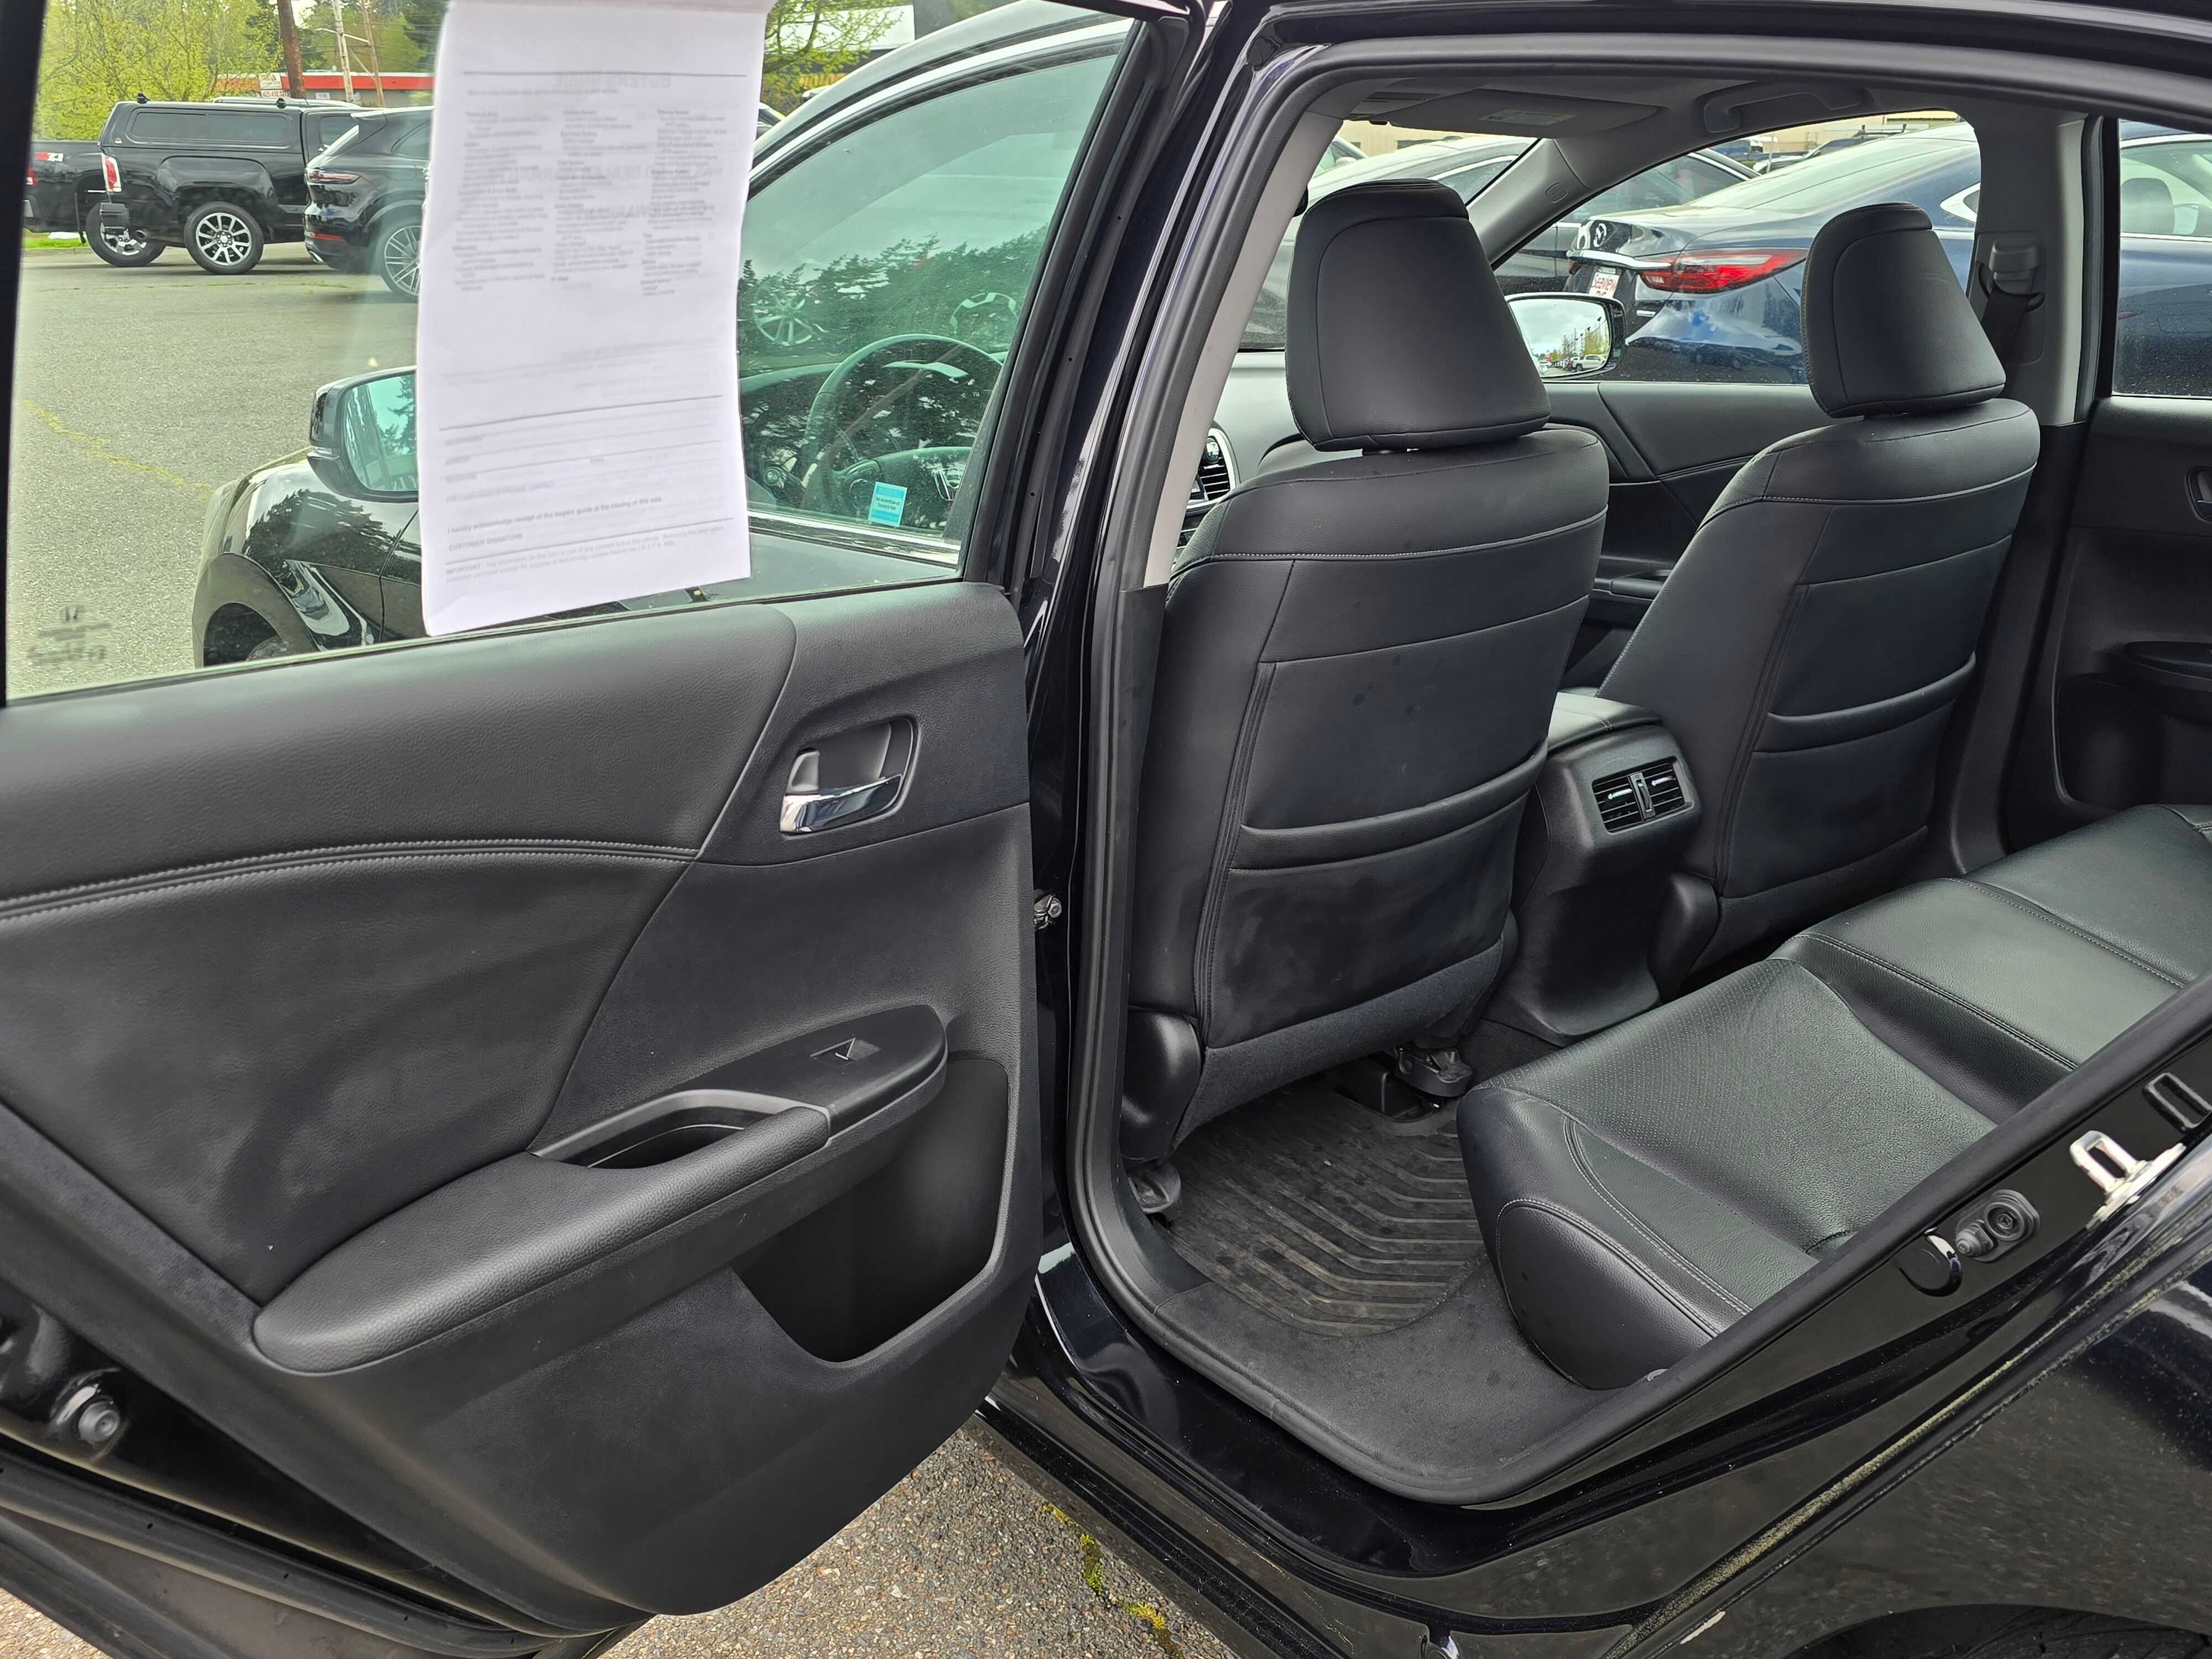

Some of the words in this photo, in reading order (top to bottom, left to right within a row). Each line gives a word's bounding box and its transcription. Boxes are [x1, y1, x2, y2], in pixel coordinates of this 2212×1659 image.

[473, 518, 513, 529] acknowledge
[554, 509, 575, 518] buyers
[577, 507, 592, 515] guide
[611, 500, 631, 509] closing
[449, 538, 485, 551] CUSTOMER
[487, 533, 522, 545] SIGNATURE
